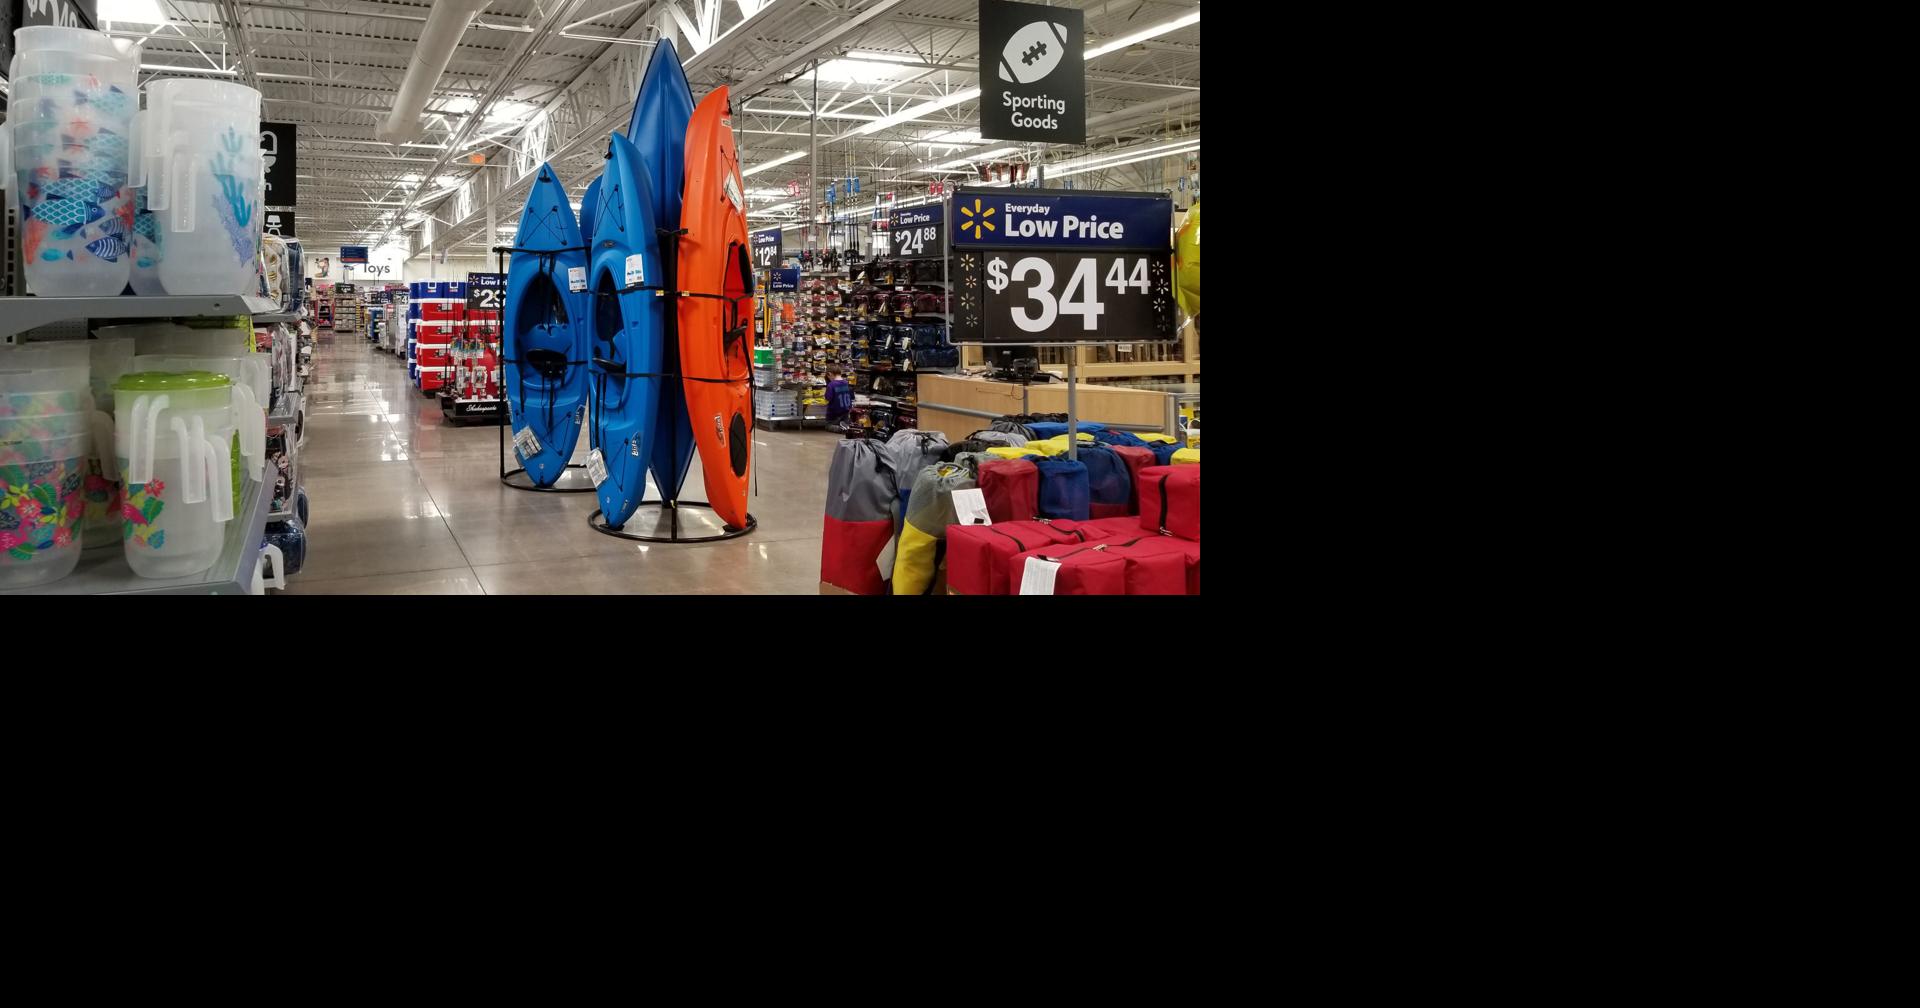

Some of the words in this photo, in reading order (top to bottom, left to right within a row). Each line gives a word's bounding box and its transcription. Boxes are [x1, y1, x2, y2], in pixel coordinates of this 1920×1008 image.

[1002, 91, 1065, 114] Sporting
[1011, 111, 1058, 129] Goods
[1005, 203, 1050, 215] Everyday
[900, 216, 913, 224] Low
[913, 213, 930, 222] Price
[1005, 214, 1058, 237] Low
[1063, 215, 1124, 239] Price
